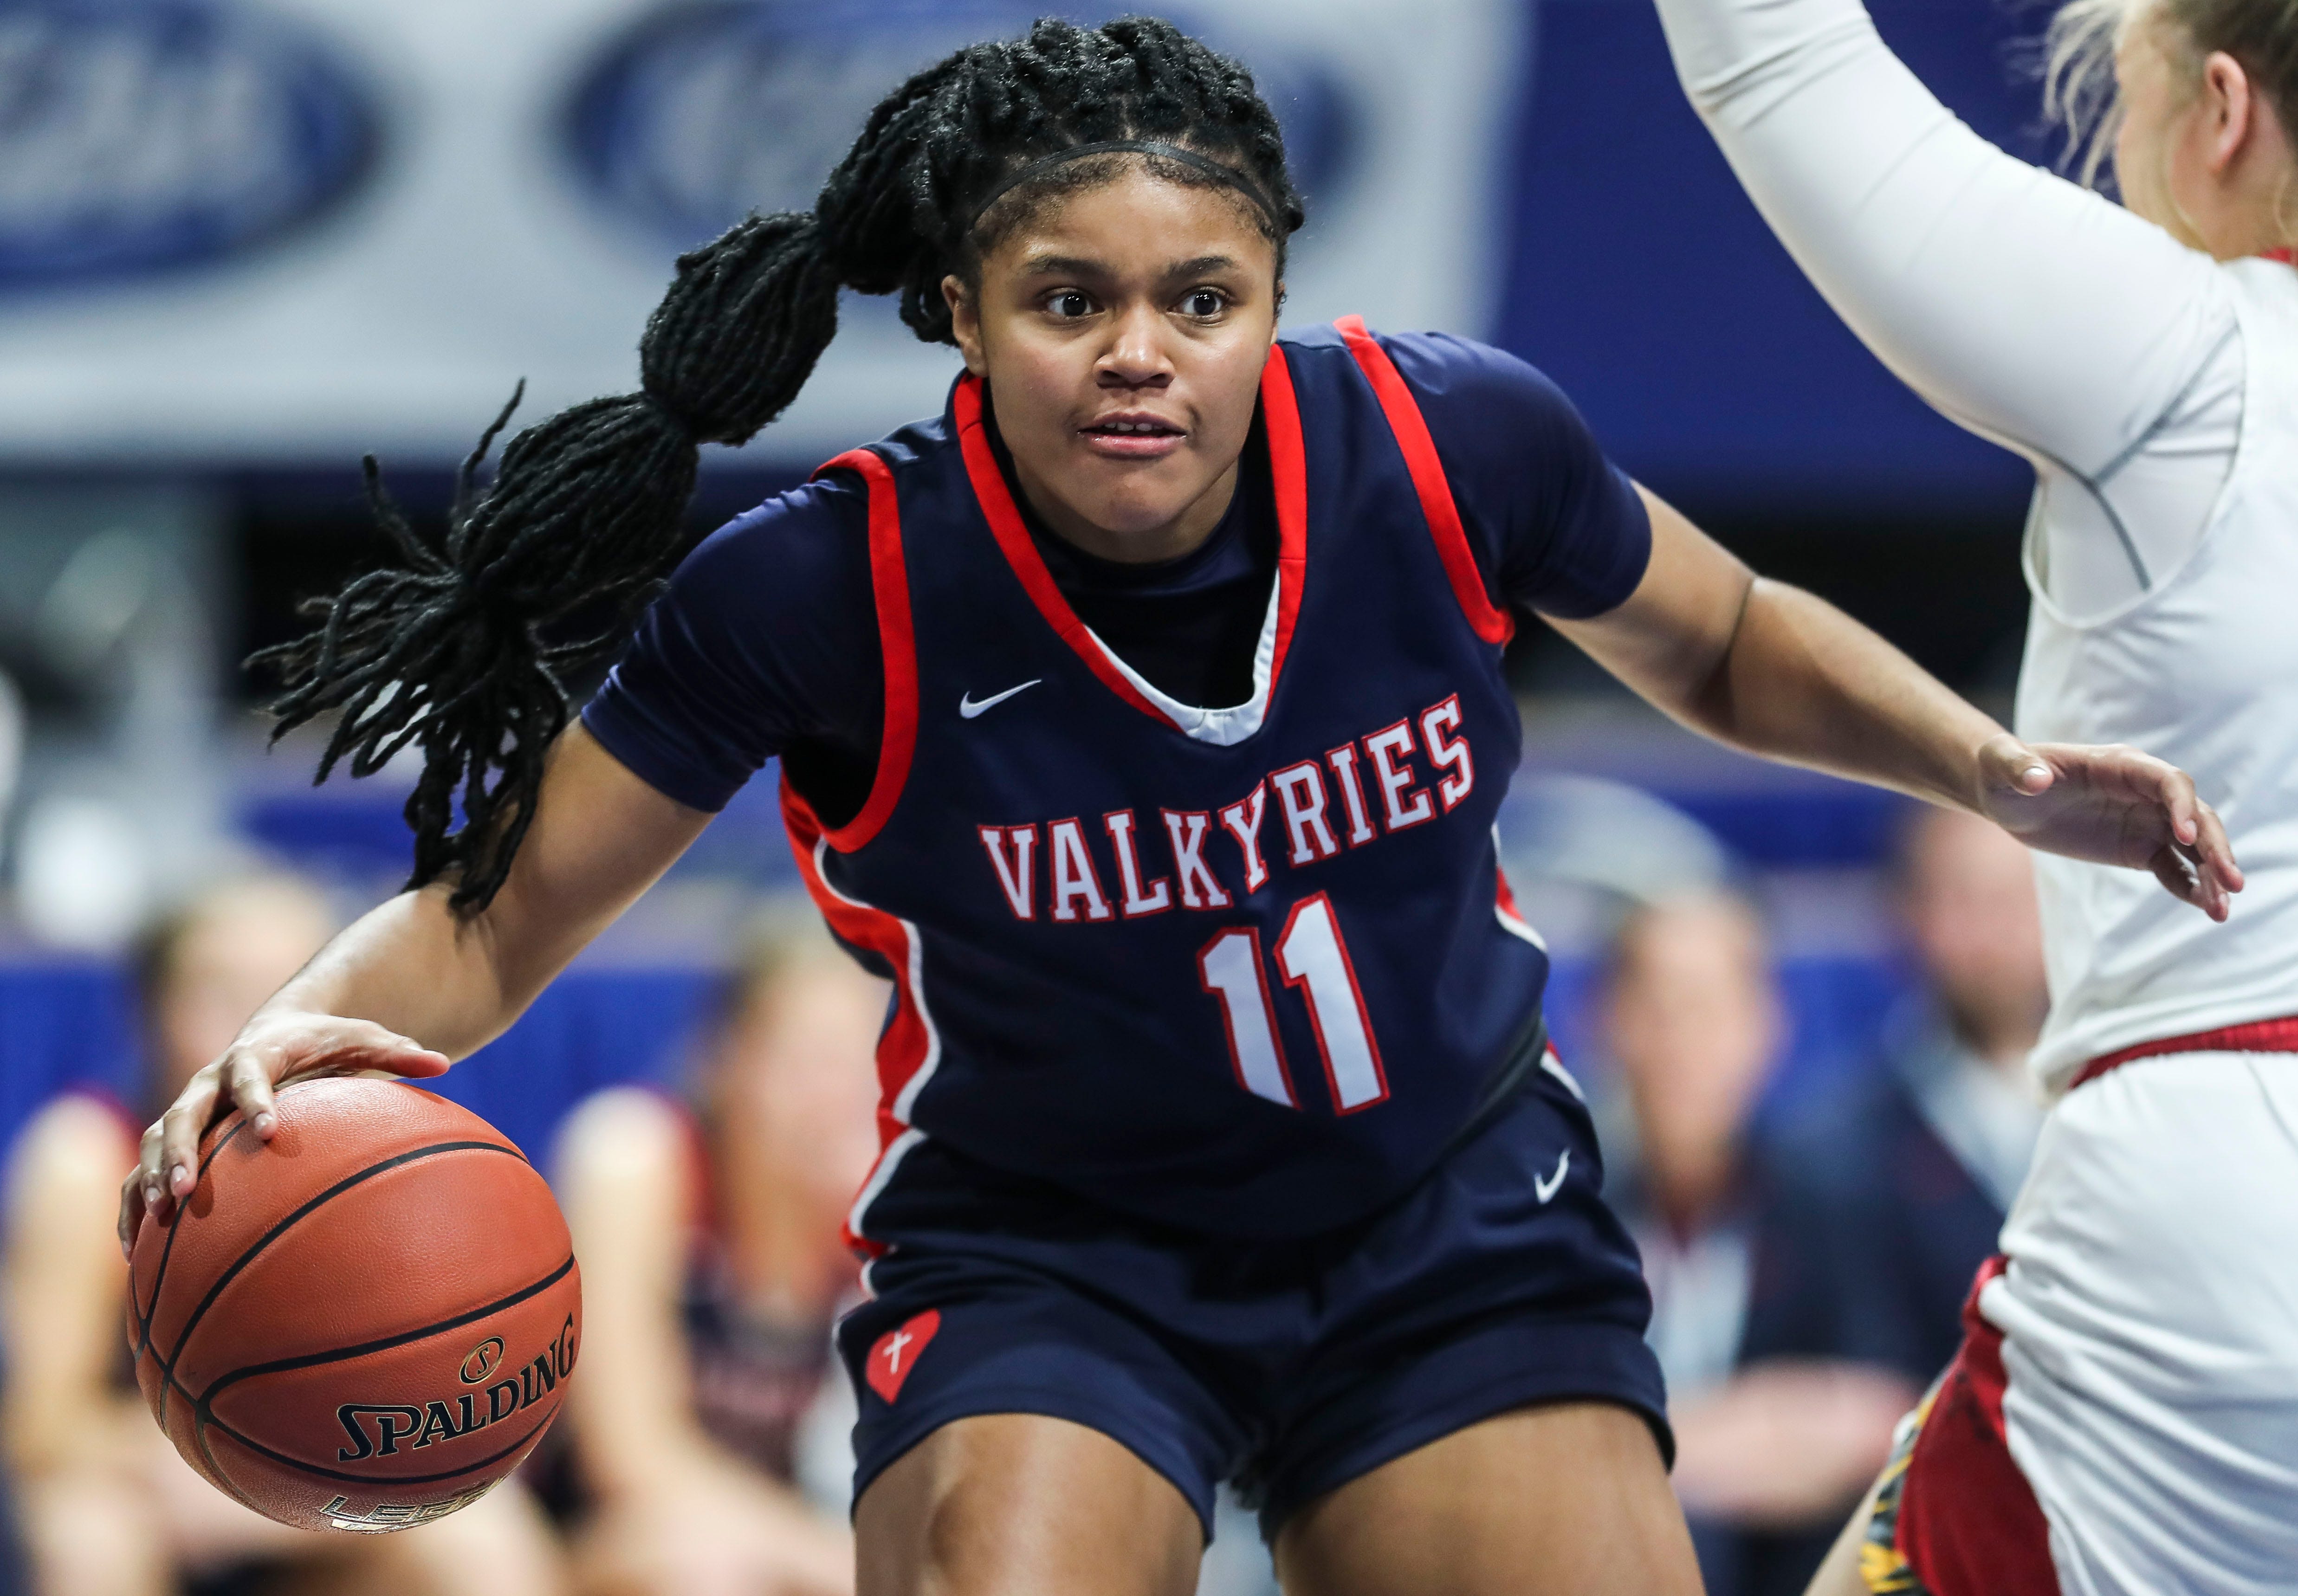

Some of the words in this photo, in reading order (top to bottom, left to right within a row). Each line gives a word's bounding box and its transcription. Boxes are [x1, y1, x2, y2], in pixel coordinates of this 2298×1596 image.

[977, 692, 1475, 923] VALKYRIES
[1196, 890, 1391, 1116] 11
[337, 1312, 574, 1462] SPALDING
